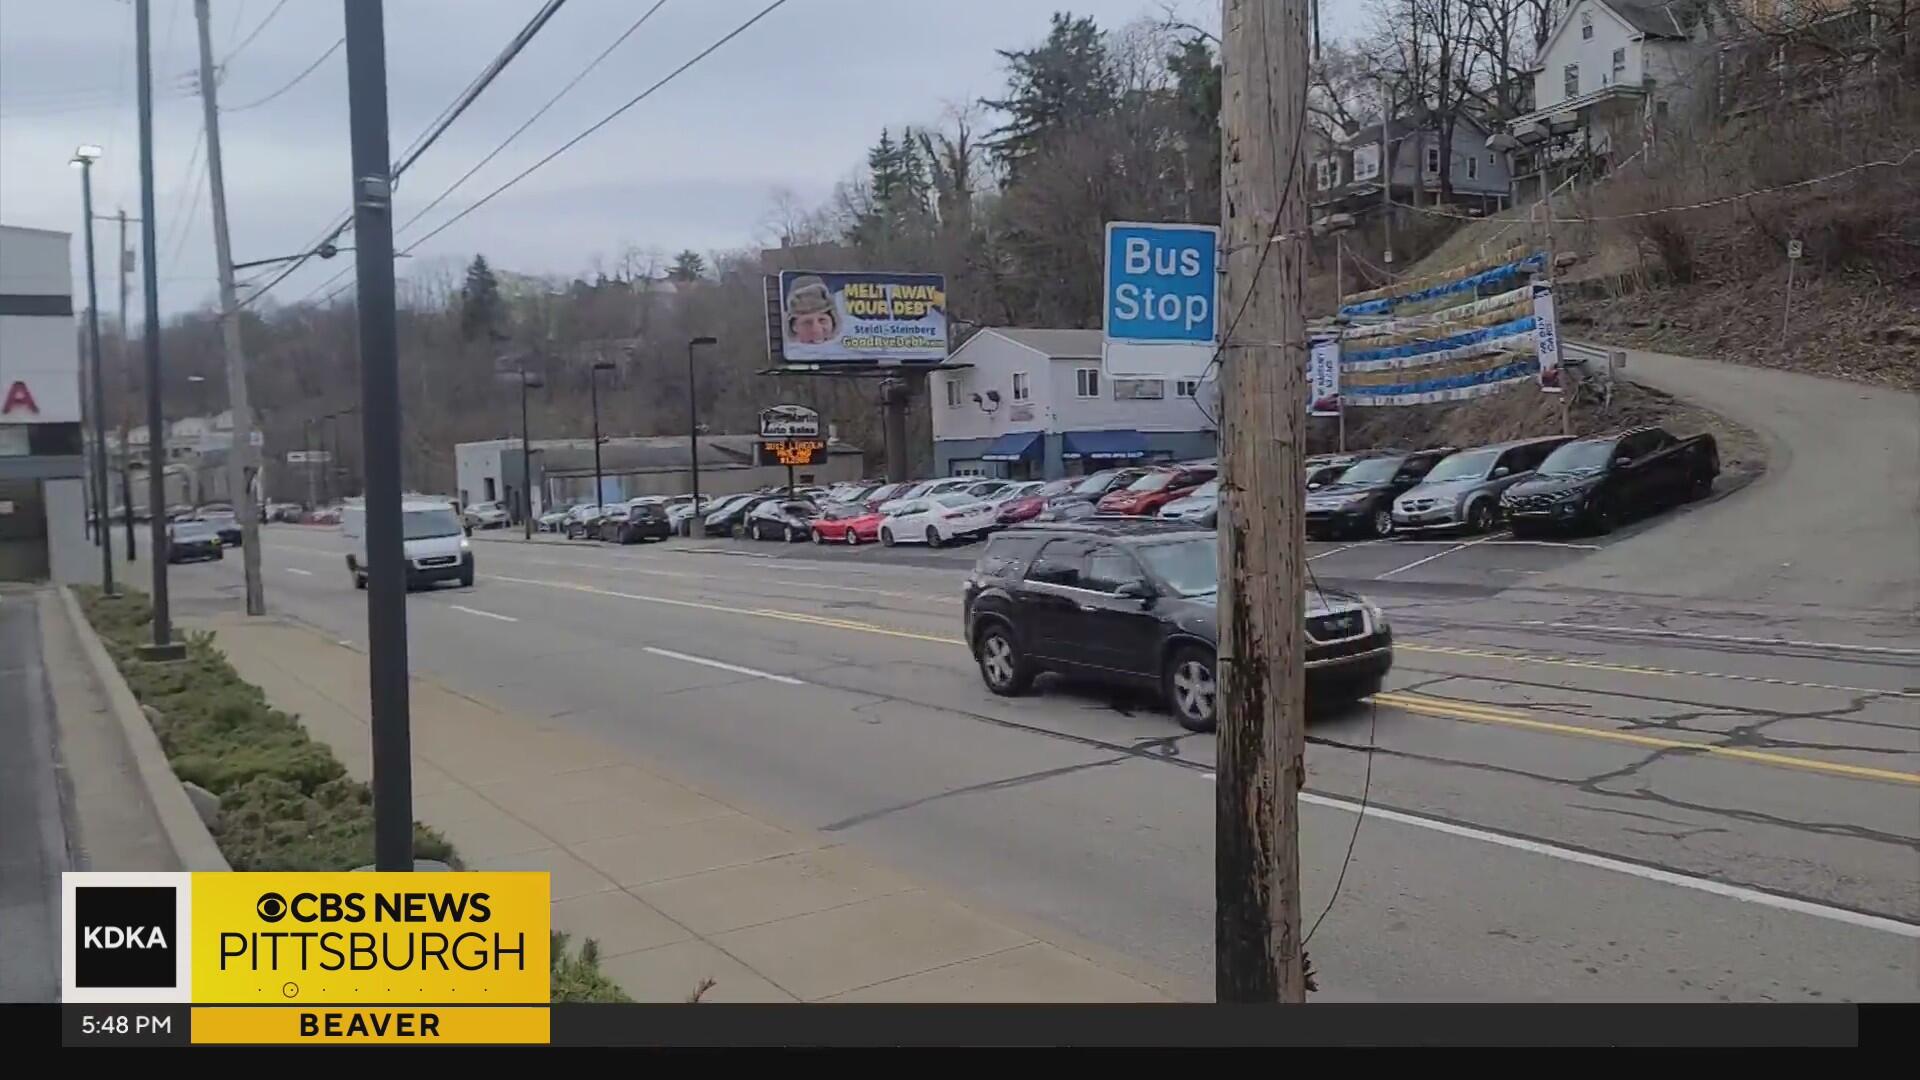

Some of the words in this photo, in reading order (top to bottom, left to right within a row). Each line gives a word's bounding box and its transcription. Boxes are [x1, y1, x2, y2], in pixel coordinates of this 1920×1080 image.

[1125, 237, 1200, 276] Bus
[844, 283, 884, 298] MELT
[892, 285, 936, 299] AWAY
[847, 300, 888, 314] YOUR
[893, 301, 933, 315] DEBT
[1114, 283, 1208, 331] Stop
[2, 381, 39, 414] A
[764, 425, 786, 433] Auto
